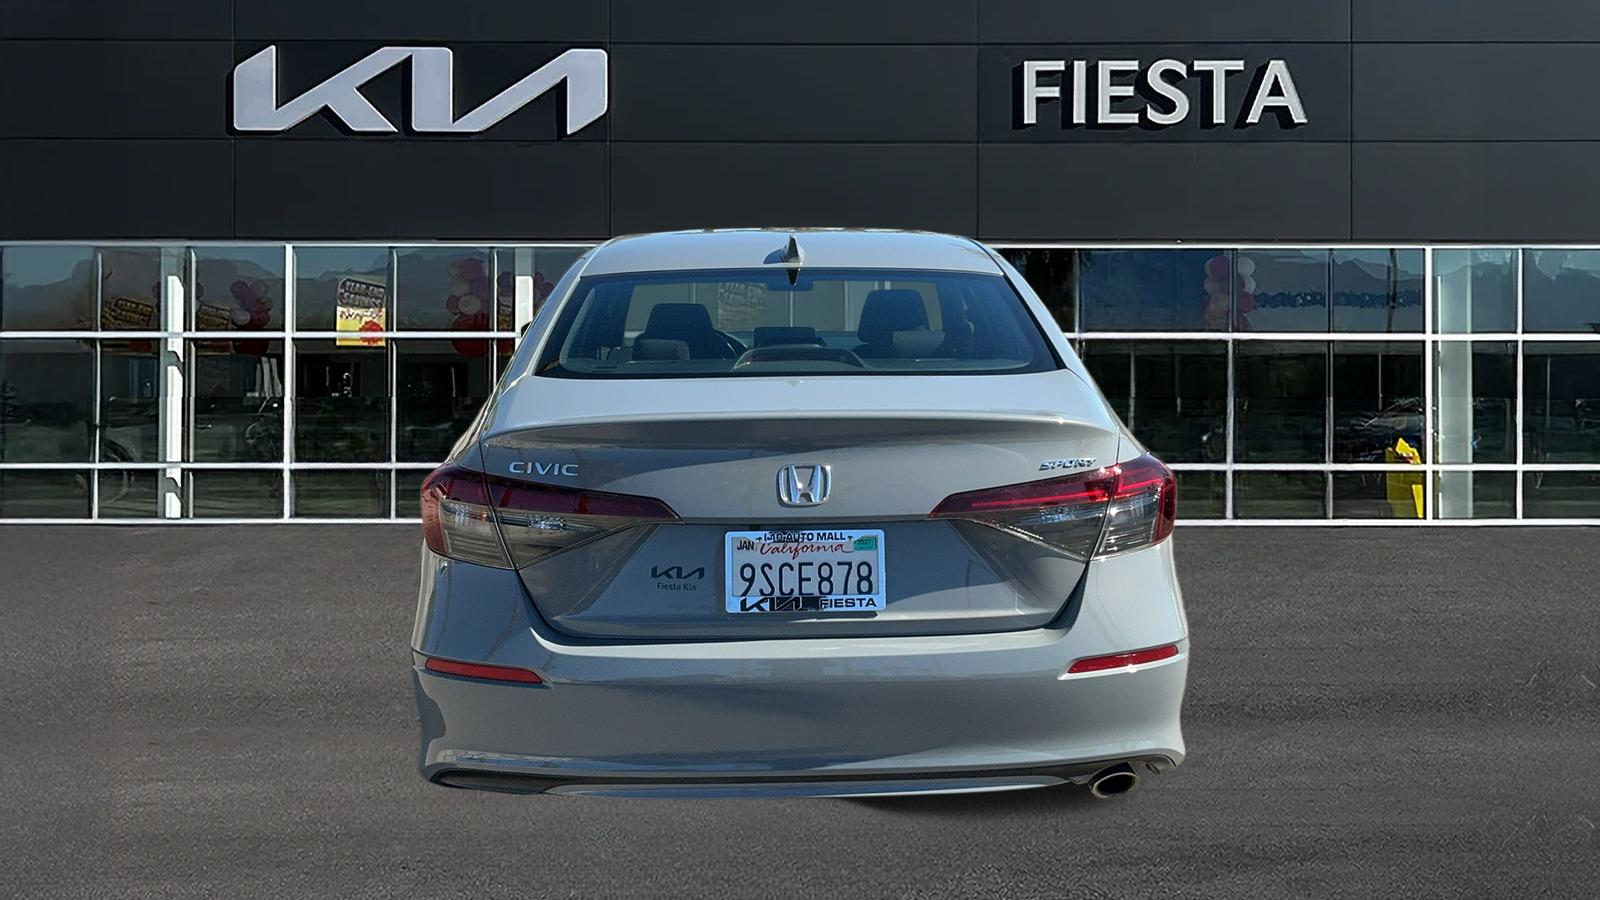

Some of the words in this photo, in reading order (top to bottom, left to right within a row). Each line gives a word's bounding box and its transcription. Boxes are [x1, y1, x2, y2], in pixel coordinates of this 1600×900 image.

[234, 44, 608, 135] KIA
[1023, 58, 1308, 125] FIESTA
[508, 461, 579, 476] CIVIC
[1038, 457, 1097, 472] SPORT
[786, 532, 814, 542] AUTO
[816, 532, 846, 541] MALL
[737, 540, 755, 551] JAN
[760, 542, 855, 560] California
[651, 565, 705, 580] KIA
[740, 560, 873, 597] 9SCE878
[656, 582, 681, 591] Fiesta
[683, 583, 697, 591] Kia
[820, 597, 877, 608] FIESTA
